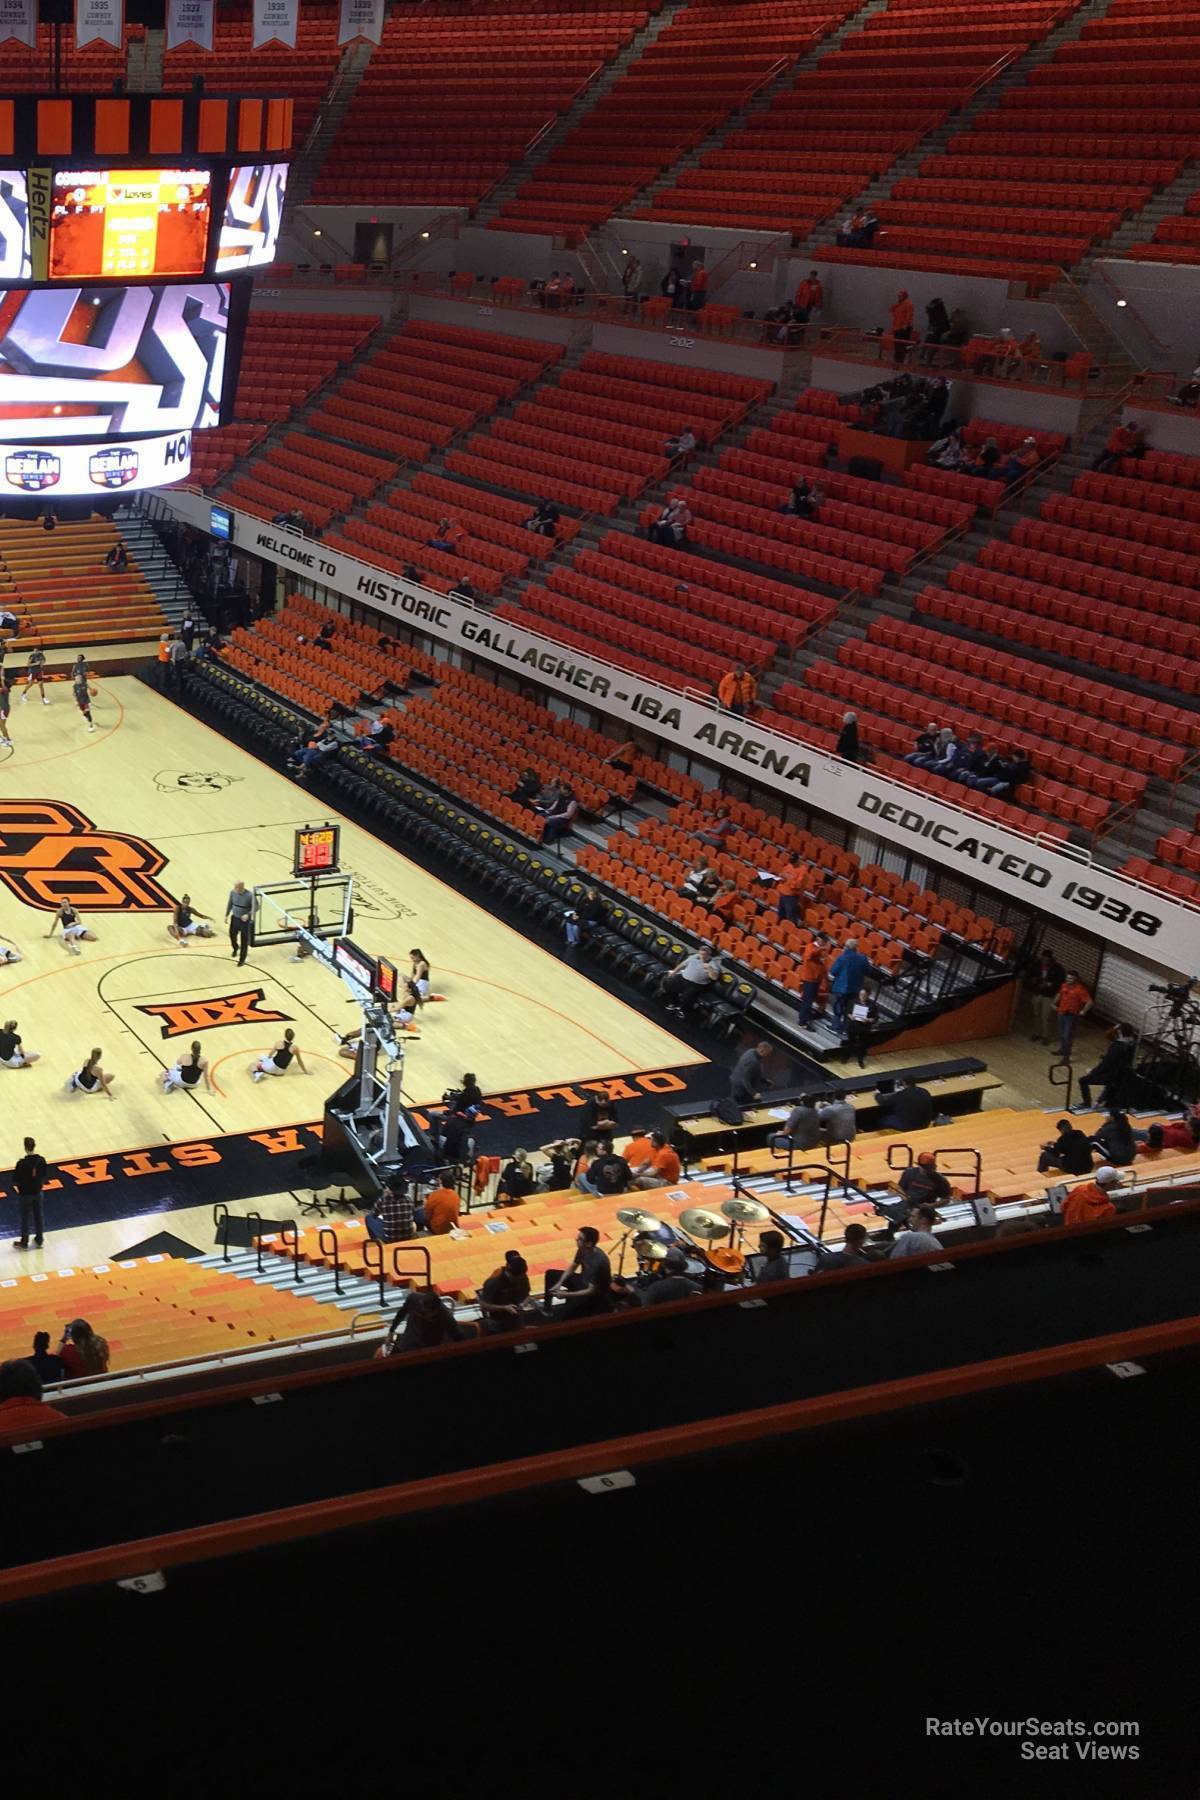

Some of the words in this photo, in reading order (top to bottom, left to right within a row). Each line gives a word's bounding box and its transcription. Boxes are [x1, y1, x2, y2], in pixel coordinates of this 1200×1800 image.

[31, 172, 49, 241] Hertz
[256, 532, 316, 568] WELCOME
[318, 557, 337, 577] TO
[357, 575, 452, 630] HISTORIC
[693, 721, 813, 788] ARENA
[856, 790, 1052, 889] DEDICATED
[1061, 880, 1164, 938] 1938
[600, 1477, 615, 1488] 6
[134, 1579, 147, 1590] 5
